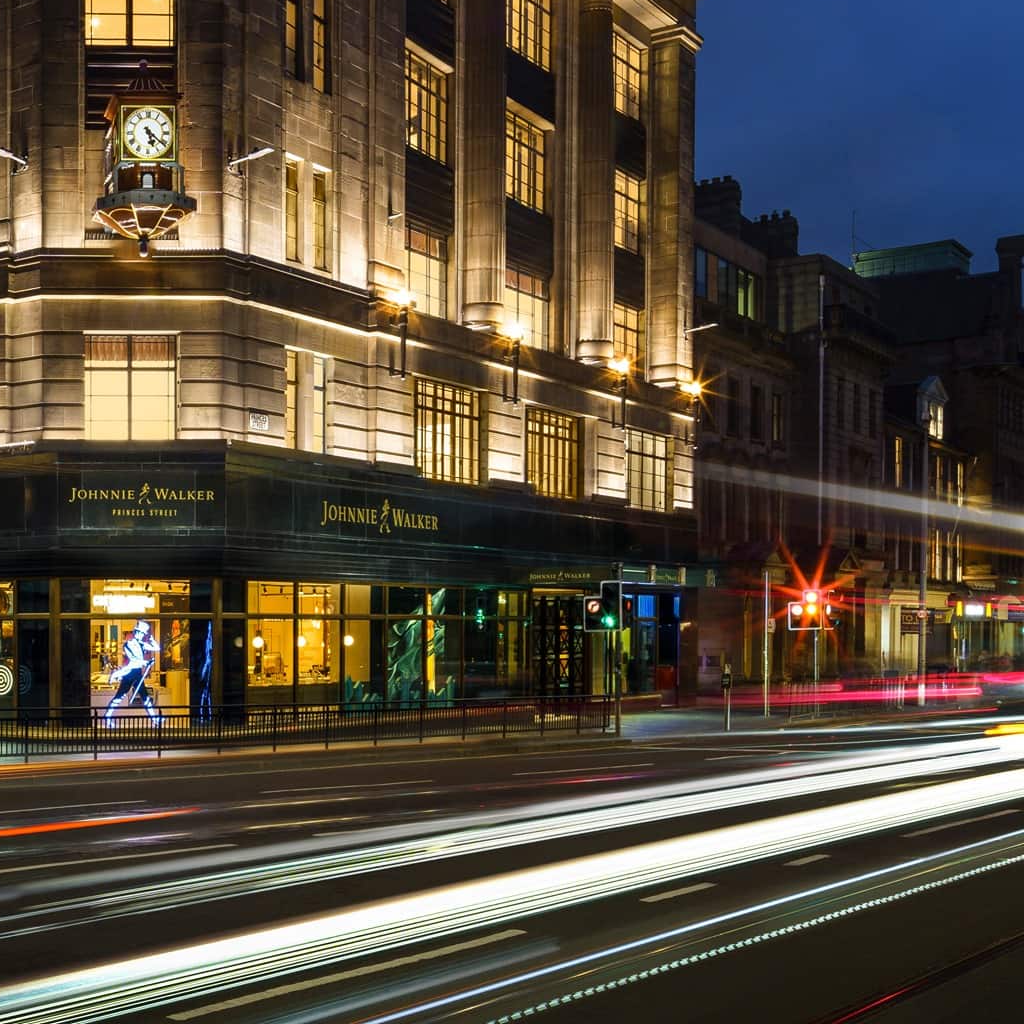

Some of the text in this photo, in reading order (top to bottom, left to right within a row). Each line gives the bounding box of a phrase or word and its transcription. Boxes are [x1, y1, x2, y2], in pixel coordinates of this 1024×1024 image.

[68, 487, 215, 503] JOHNNIE WALKER
[112, 509, 178, 517] PRINCES STREET
[320, 500, 439, 531] JOHNNIE WALKER
